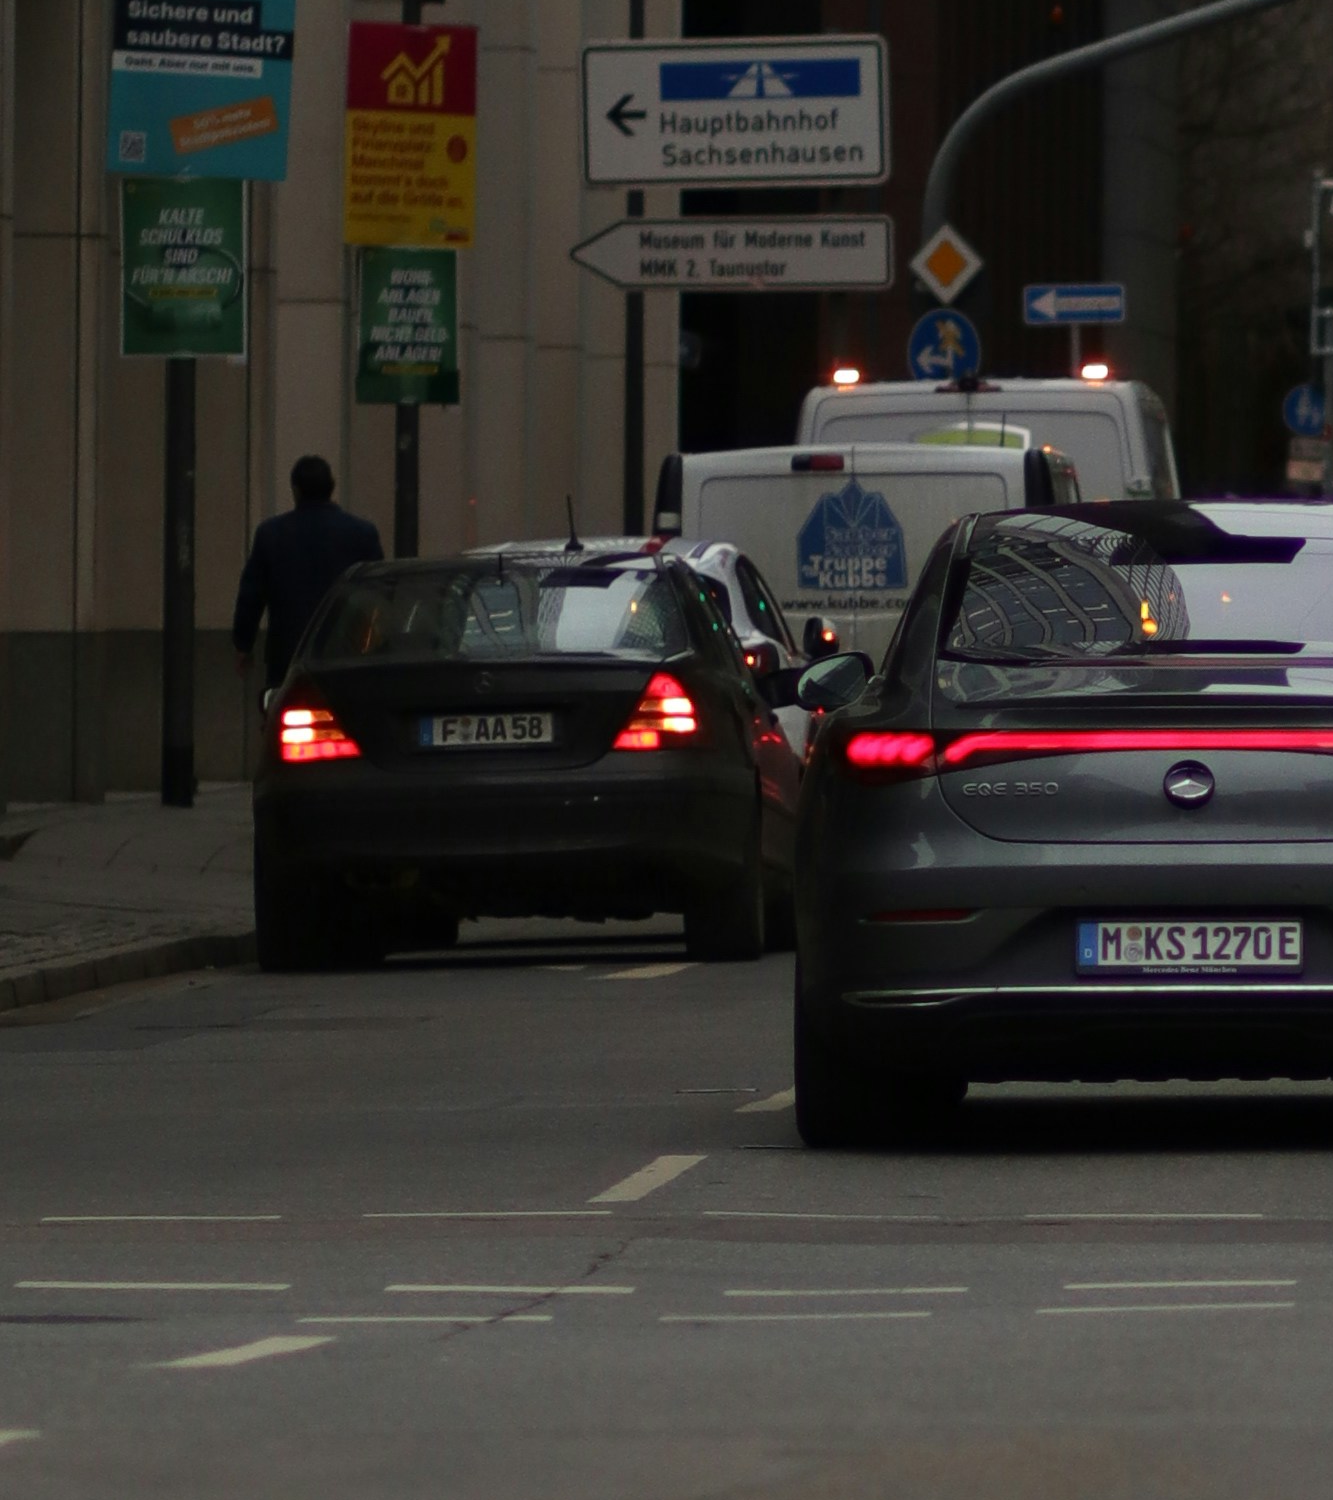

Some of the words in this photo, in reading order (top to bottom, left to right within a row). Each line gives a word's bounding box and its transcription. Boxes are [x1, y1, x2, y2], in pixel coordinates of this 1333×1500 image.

[128, 1, 208, 21] Sichere
[213, 6, 254, 25] und
[126, 29, 212, 48] saubere
[217, 31, 286, 54] Stadt?
[660, 108, 839, 137] Hauptbahnhof
[662, 141, 864, 167] Sachsenhausen
[158, 208, 205, 225] KALTE
[139, 227, 224, 246] SCHULKLOS
[640, 230, 704, 249] Museum
[714, 228, 736, 248] für
[745, 230, 813, 249] Moderne
[821, 230, 866, 248] Kunst
[163, 248, 199, 265] SIND
[176, 267, 233, 285] ARSCH!
[640, 259, 678, 277] MMK
[709, 258, 788, 277] Taunustor
[809, 554, 887, 573] Truppe
[818, 570, 887, 588] Kubbe
[782, 595, 908, 610] www.kubbe.co
[511, 716, 543, 740] 58
[962, 782, 1008, 797] EQE
[1013, 782, 1059, 796] 350
[1101, 926, 1121, 961] M
[1144, 926, 1186, 961] KS
